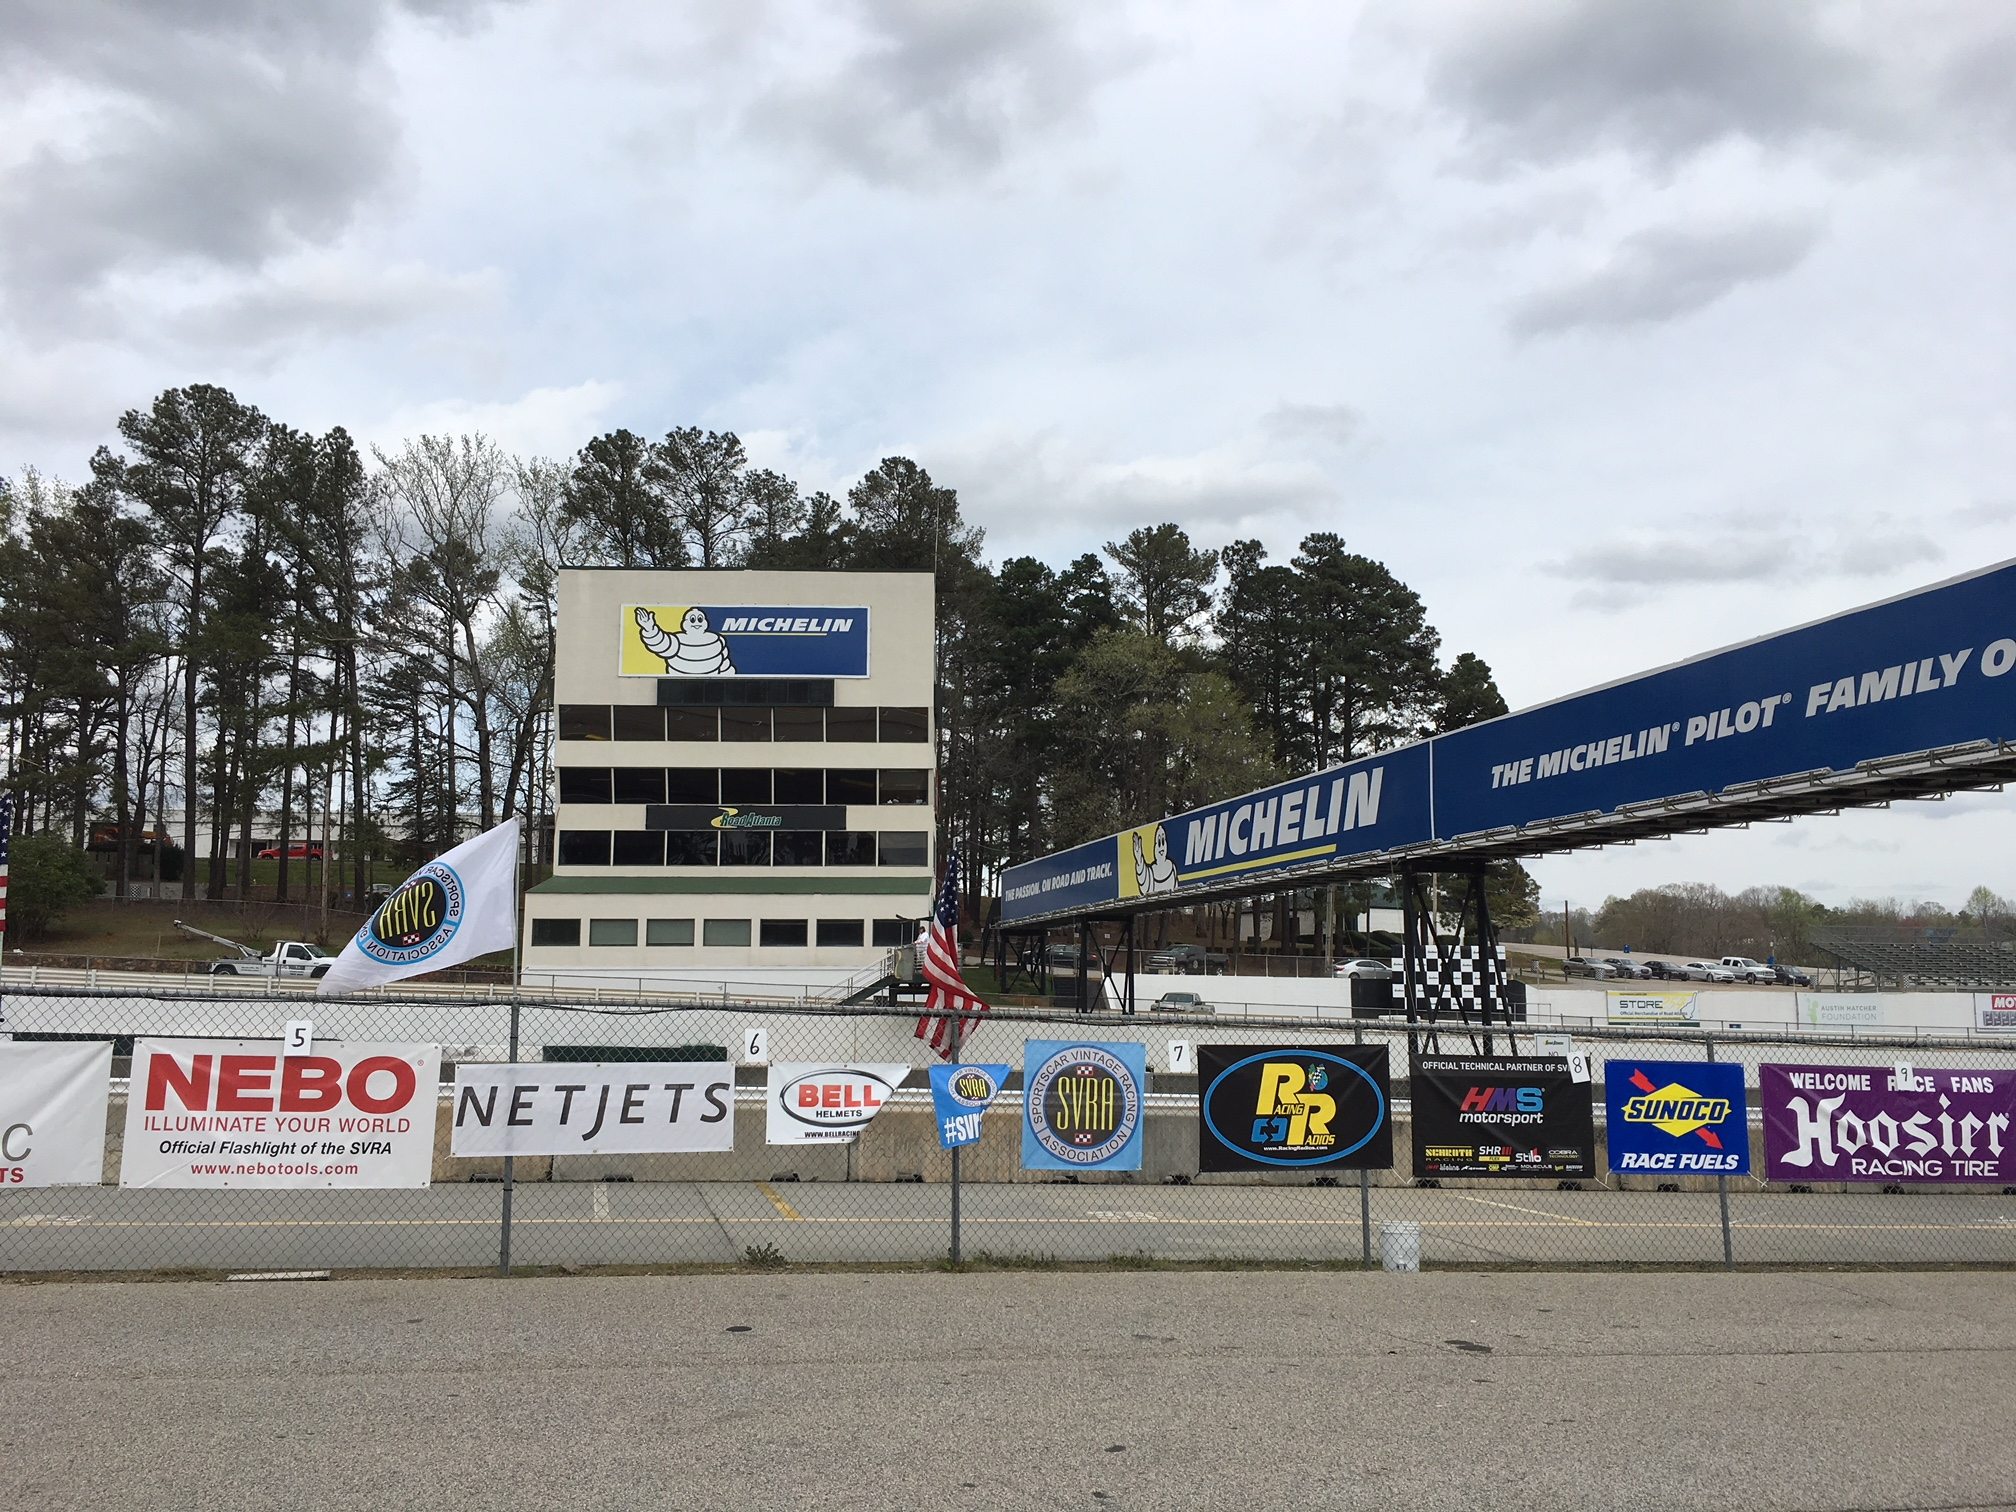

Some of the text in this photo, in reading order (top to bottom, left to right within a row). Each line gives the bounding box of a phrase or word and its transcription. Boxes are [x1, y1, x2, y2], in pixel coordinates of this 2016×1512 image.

[722, 617, 853, 632] MICHELIN
[1491, 758, 1534, 789] THE
[1805, 648, 1973, 718] FAMILY
[1185, 767, 1383, 866] MICHELIN
[1005, 862, 1113, 901] THE PASSION. ON ROAD AND TRACK.
[1620, 1000, 1663, 1009] STORE
[1821, 1012, 1877, 1021] FOUNDATION
[290, 1028, 307, 1047] 5
[750, 1033, 760, 1055] 6
[1174, 1045, 1183, 1062] 7
[1422, 1061, 1571, 1072] OFFICIAL TECHNICAL PARTNER OF SV
[1572, 1056, 1582, 1074] 8
[1900, 1067, 1908, 1082] 9
[959, 1078, 987, 1098] SVRA
[1032, 1054, 1070, 1124] SPORTSCAR
[1071, 1050, 1122, 1075] VINTAGE
[1120, 1074, 1136, 1123] RACING
[1789, 1072, 1994, 1093] WELCOME RCE FANS
[798, 1084, 881, 1108] BELL
[1057, 1076, 1114, 1131] SVRA
[455, 1082, 731, 1142] NETJETS
[815, 1109, 863, 1118] HELMETS
[1459, 1112, 1543, 1127] motorsport
[1627, 1099, 1727, 1121] SUNOCO
[144, 1116, 411, 1133] ILLUMINATE YOUR WORLD
[1781, 1092, 2010, 1167] Hoosier
[2, 1123, 34, 1162] C
[159, 1140, 392, 1158] Official Flashlight of the SVRA
[1042, 1130, 1127, 1162] ASSOCIATION
[1479, 1146, 1501, 1155] SHR
[1515, 1149, 1542, 1163] Stilo
[1621, 1152, 1739, 1170] RACE FUELS
[190, 1162, 359, 1175] www.nebotools.com
[1851, 1158, 1999, 1177] RACING TIRE
